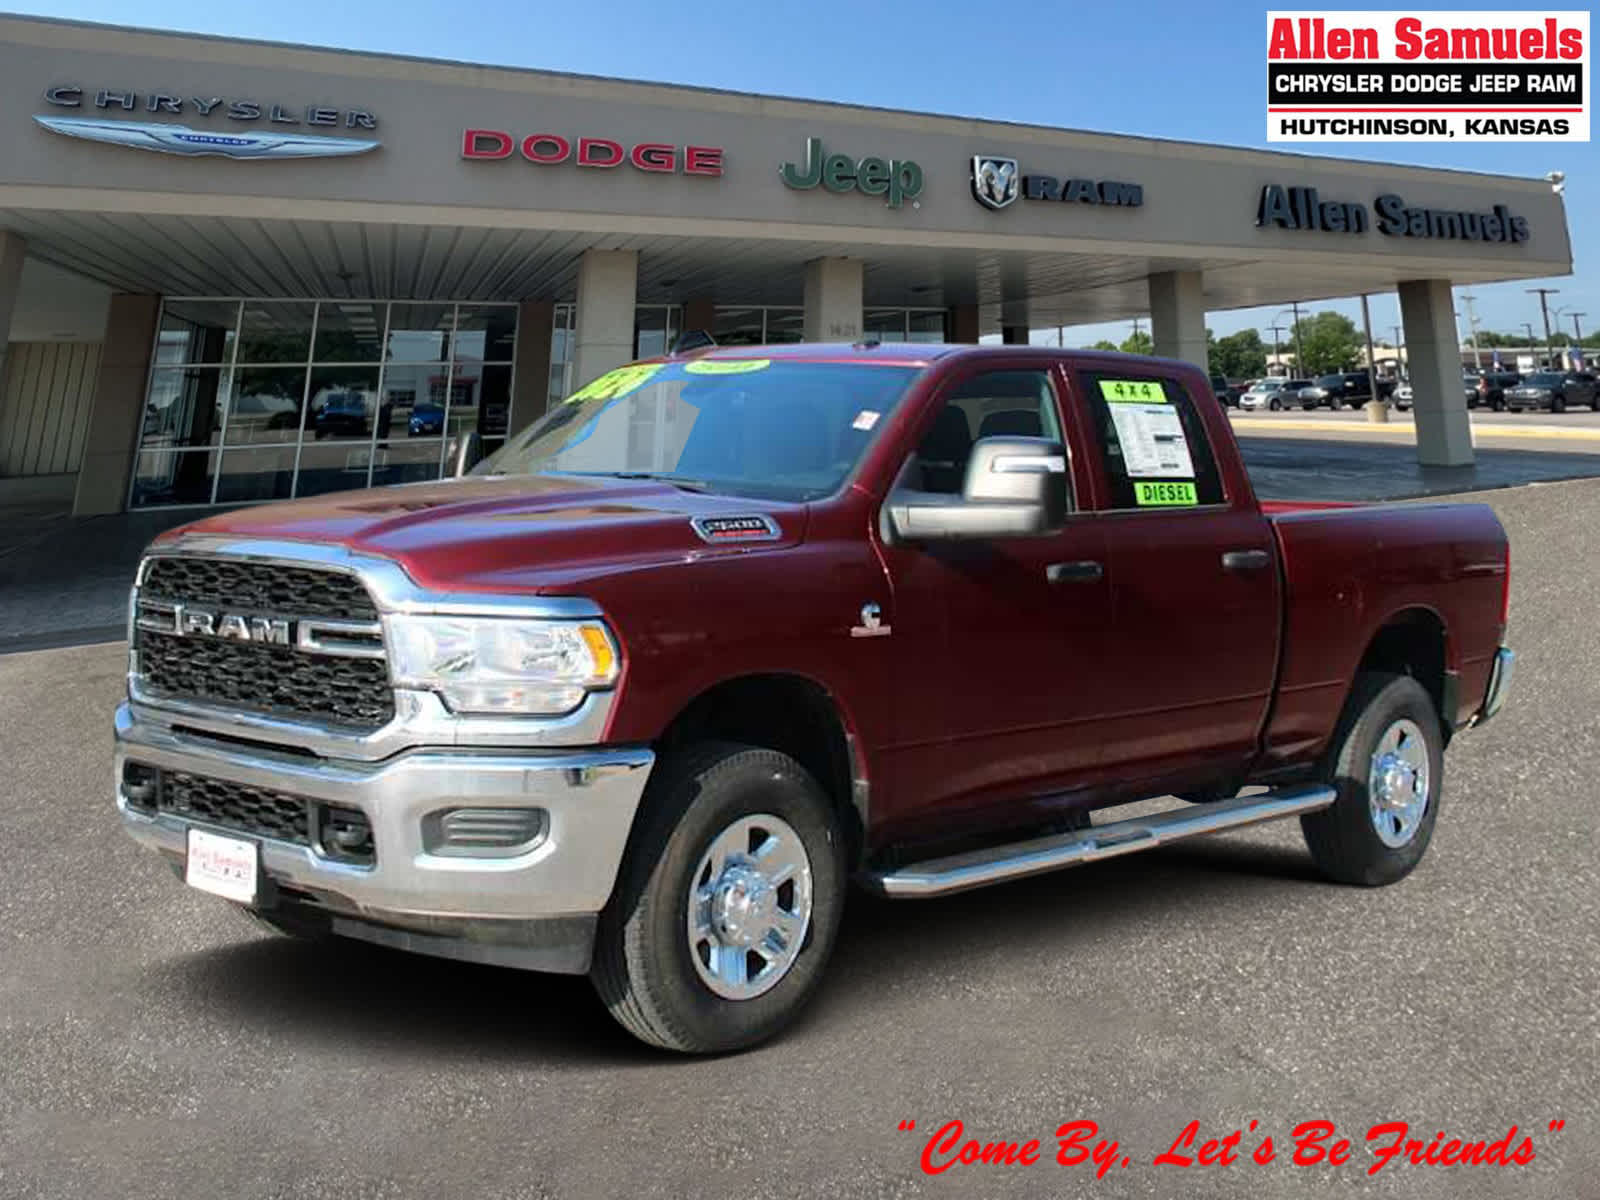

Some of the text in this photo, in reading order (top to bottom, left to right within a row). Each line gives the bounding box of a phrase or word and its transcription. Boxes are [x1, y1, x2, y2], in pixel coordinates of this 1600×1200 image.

[44, 86, 378, 129] CHRYSLER
[461, 128, 724, 175] DODGE
[779, 137, 923, 208] Jeep
[1023, 175, 1144, 207] RAM
[1255, 185, 1530, 243] Allen Samuels
[1143, 485, 1193, 501] DIESEL
[184, 612, 289, 645] RAM
